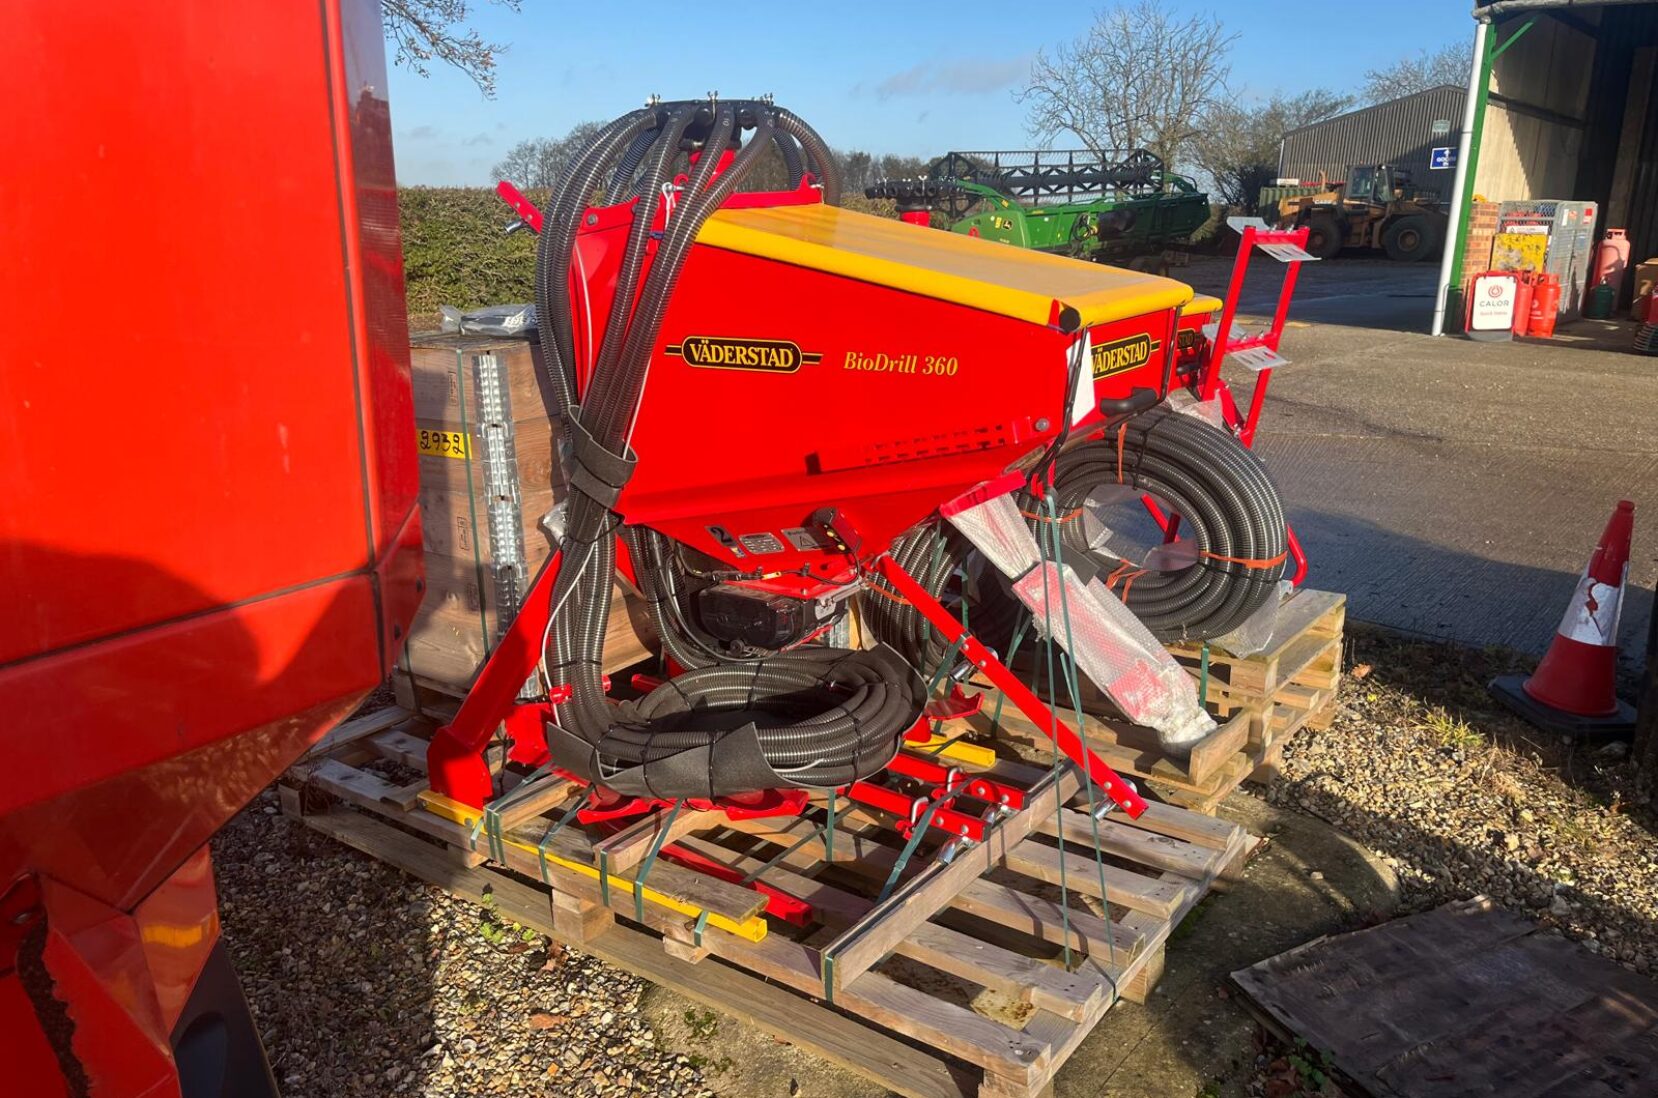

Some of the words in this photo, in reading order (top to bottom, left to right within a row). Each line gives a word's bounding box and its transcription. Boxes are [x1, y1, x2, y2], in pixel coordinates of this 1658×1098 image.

[1479, 300, 1510, 308] CALOR
[689, 339, 794, 368] VÄDERSTAD
[843, 351, 918, 374] BioDrill
[922, 355, 959, 376] 360
[710, 526, 733, 543] 2
